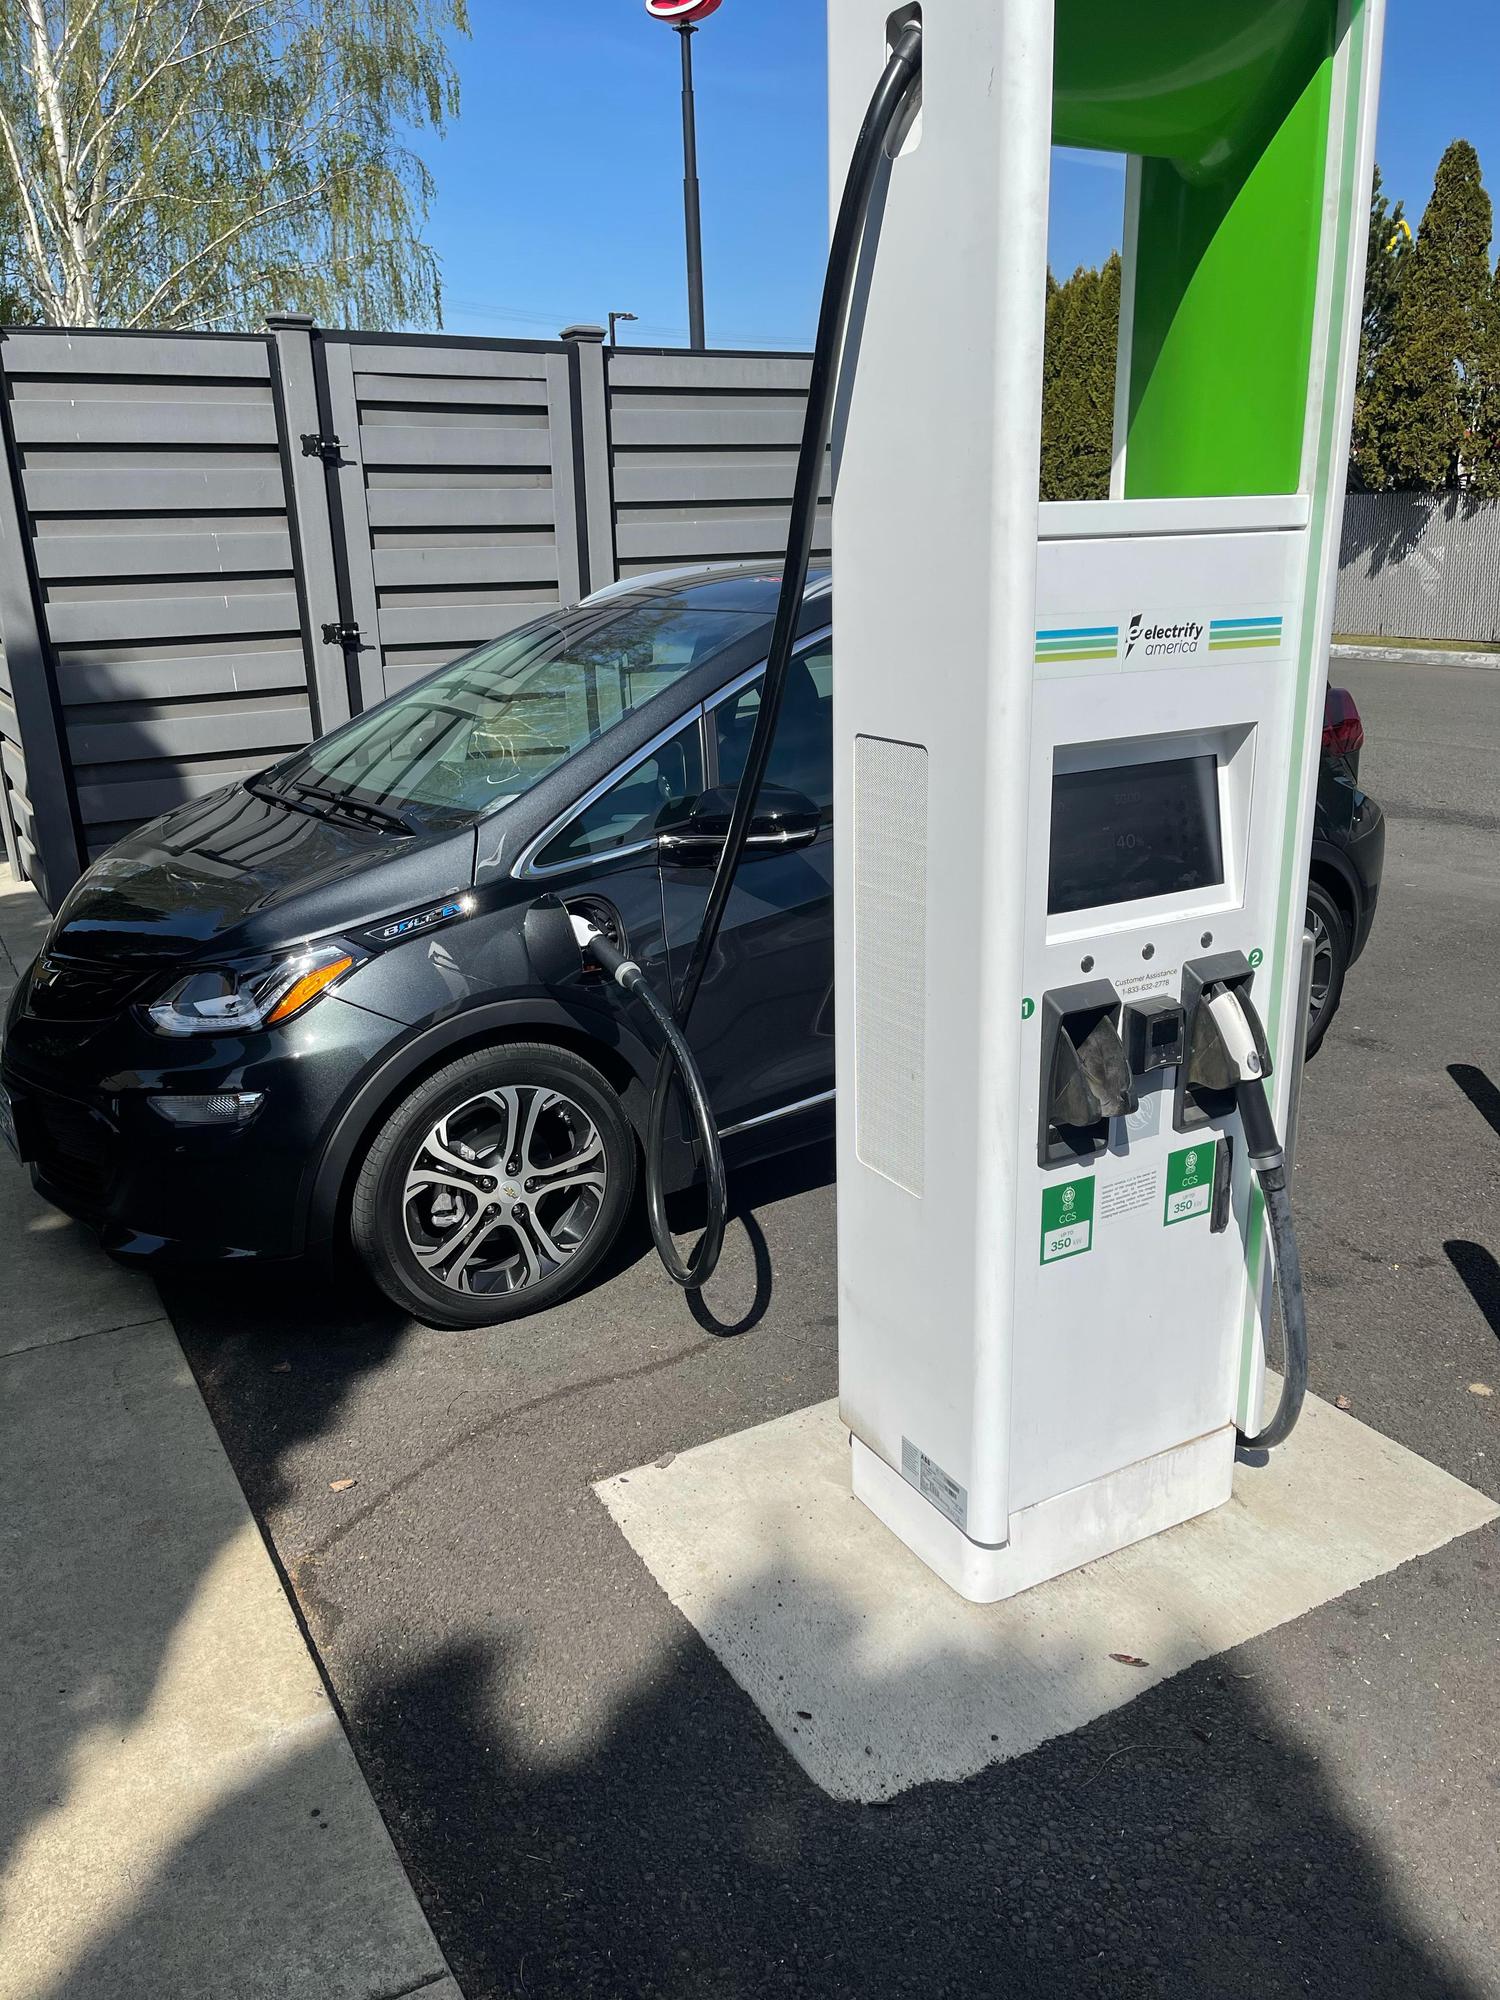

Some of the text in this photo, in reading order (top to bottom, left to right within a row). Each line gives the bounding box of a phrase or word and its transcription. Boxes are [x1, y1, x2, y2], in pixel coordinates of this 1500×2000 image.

[1145, 622, 1203, 641] electrify
[1145, 640, 1198, 656] america
[1115, 969, 1177, 987] Customer Assistance
[1182, 1175, 1198, 1187] CCS
[1174, 1200, 1192, 1214] 350
[1059, 1211, 1077, 1224] CCS
[1050, 1237, 1071, 1252] 350
